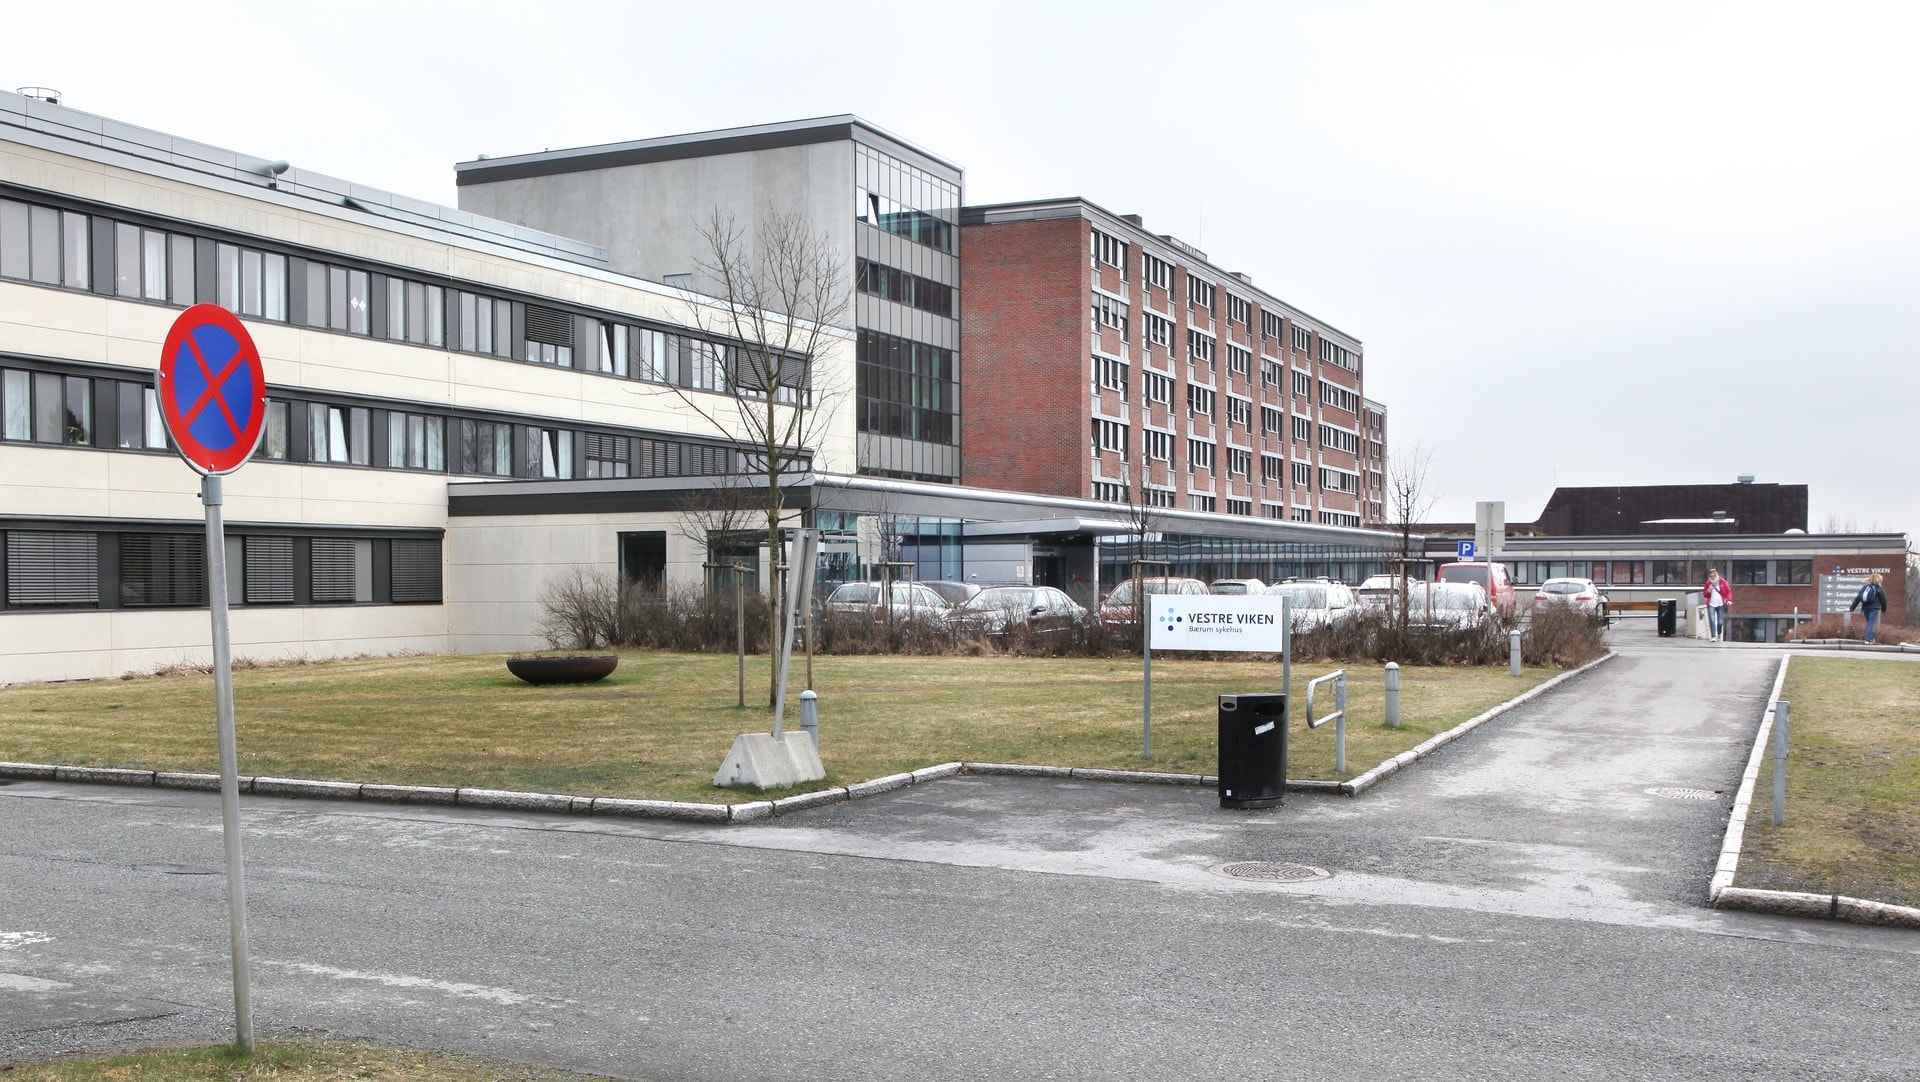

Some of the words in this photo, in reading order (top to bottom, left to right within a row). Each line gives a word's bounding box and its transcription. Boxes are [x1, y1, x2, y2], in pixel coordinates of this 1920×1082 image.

[1462, 543, 1472, 555] P
[1188, 613, 1233, 624] VESTRE
[1236, 614, 1274, 625] VIKEN
[1215, 626, 1243, 634] sykehus
